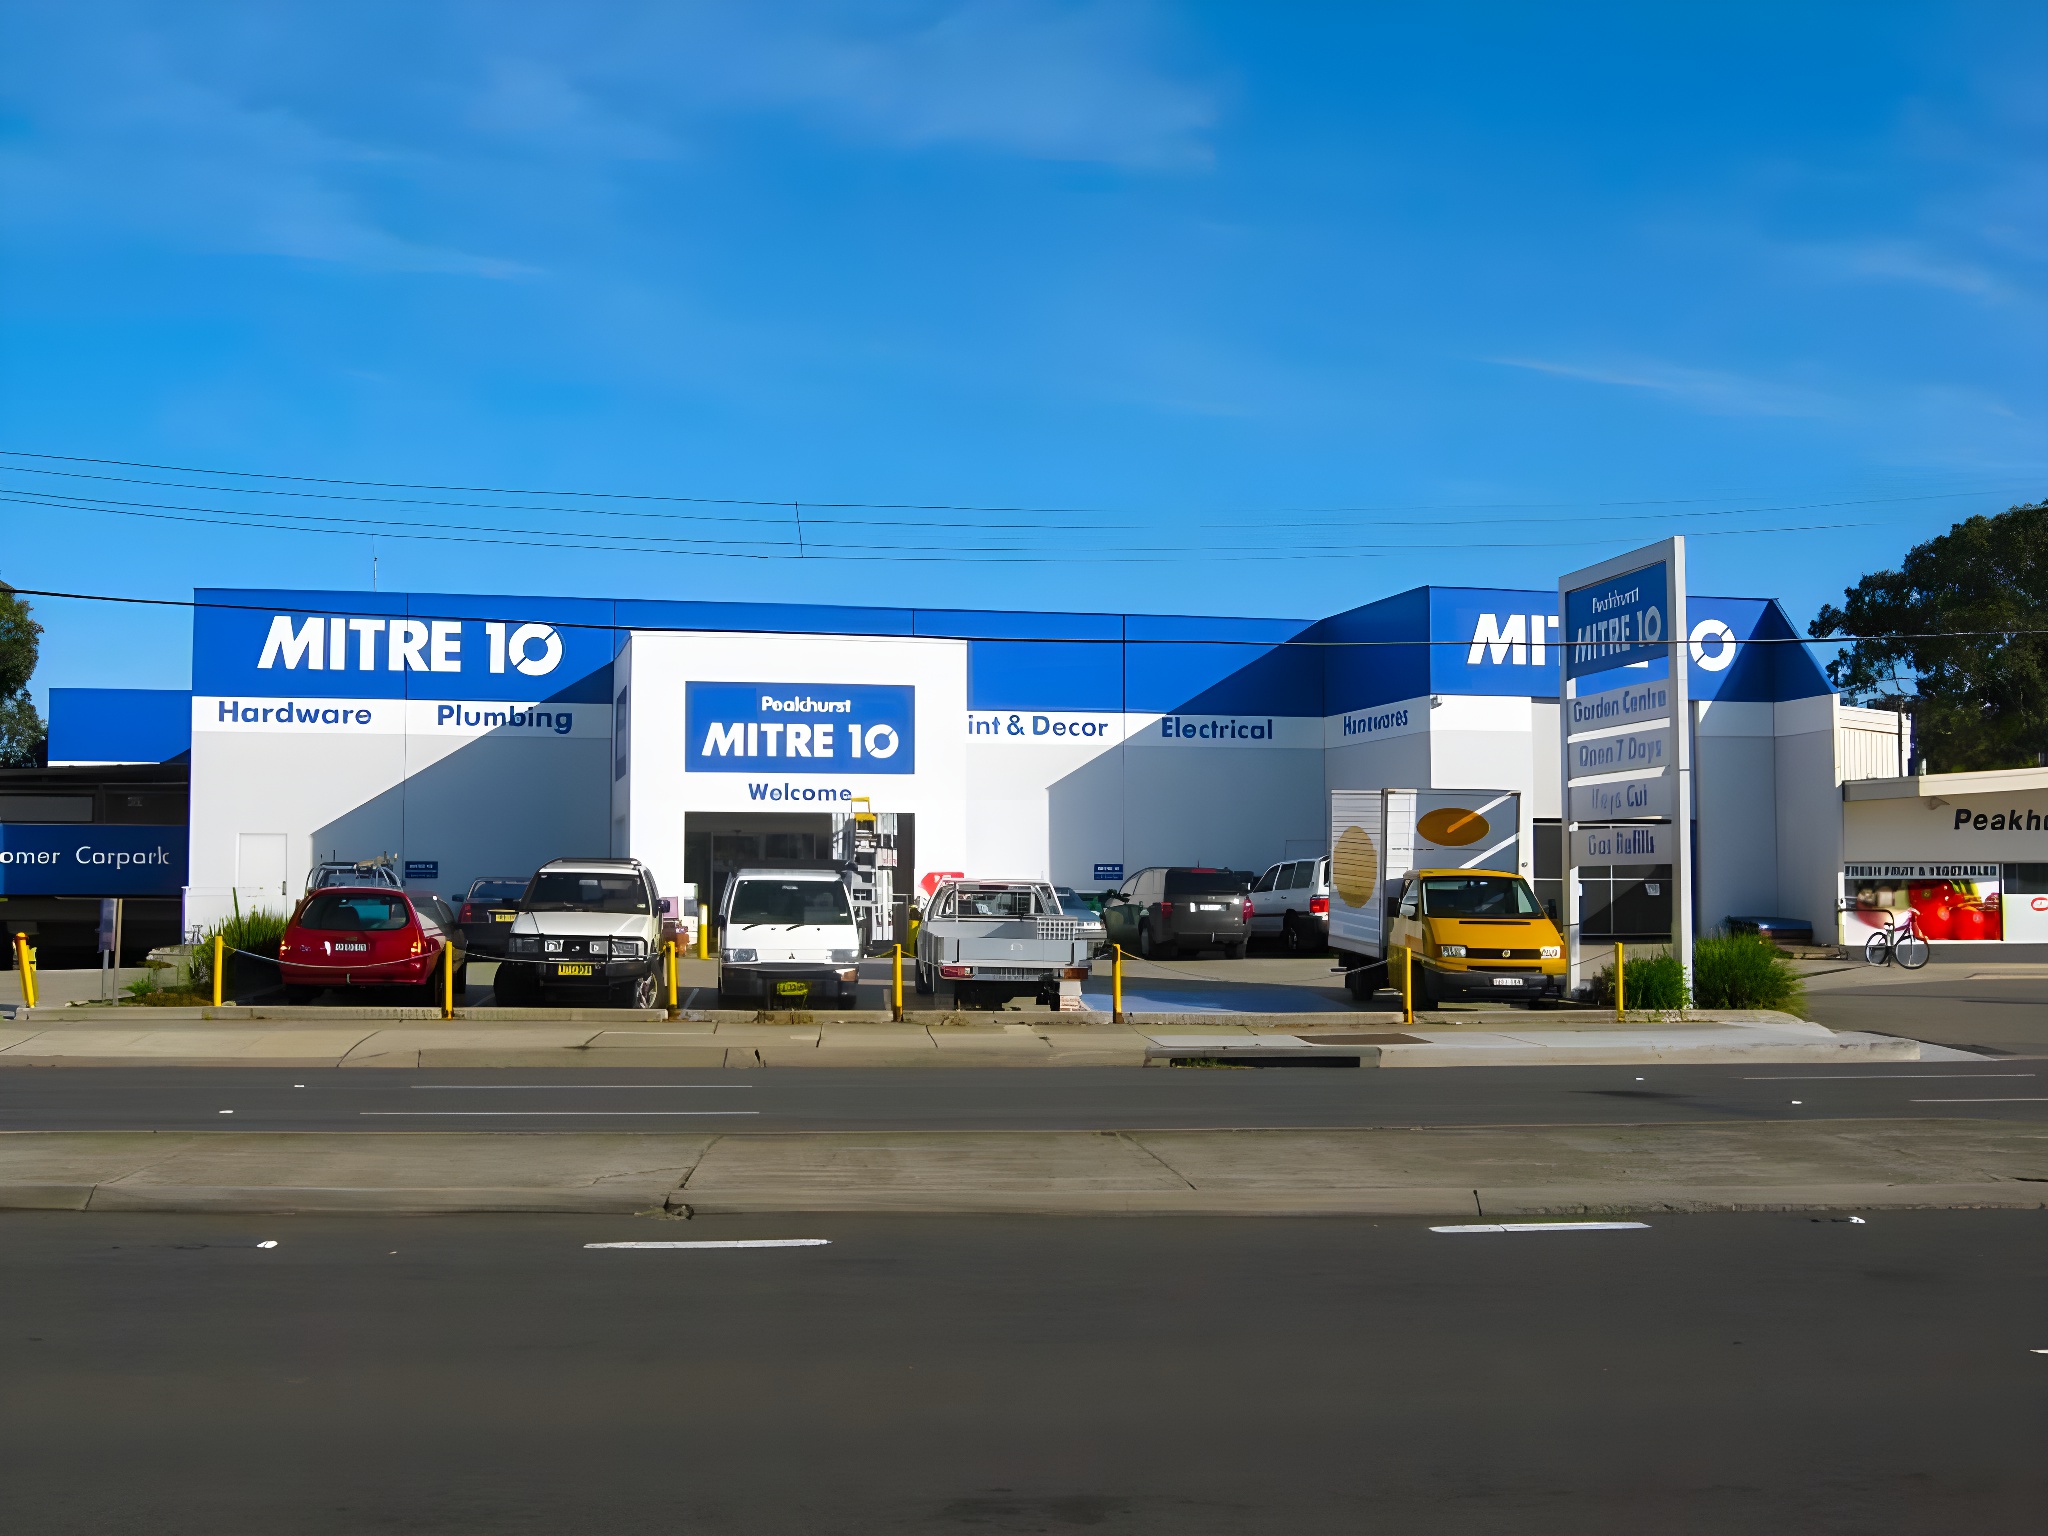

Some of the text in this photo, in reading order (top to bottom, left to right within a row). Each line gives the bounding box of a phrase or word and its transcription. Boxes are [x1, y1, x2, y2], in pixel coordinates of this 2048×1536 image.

[257, 615, 563, 676] MITRE 10
[1575, 614, 1631, 664] MITRE
[1636, 605, 1662, 648] 10
[218, 700, 372, 726] Hardware
[437, 704, 573, 735] Plumbing
[1006, 714, 1026, 736] &
[1032, 715, 1109, 737] Decor
[701, 721, 899, 759] MITRE 10
[1161, 716, 1273, 740] Electrical
[1616, 738, 1624, 762] 7
[748, 782, 852, 801] Welcome
[1953, 808, 2048, 831] Peakh
[75, 845, 172, 870] Carpark
